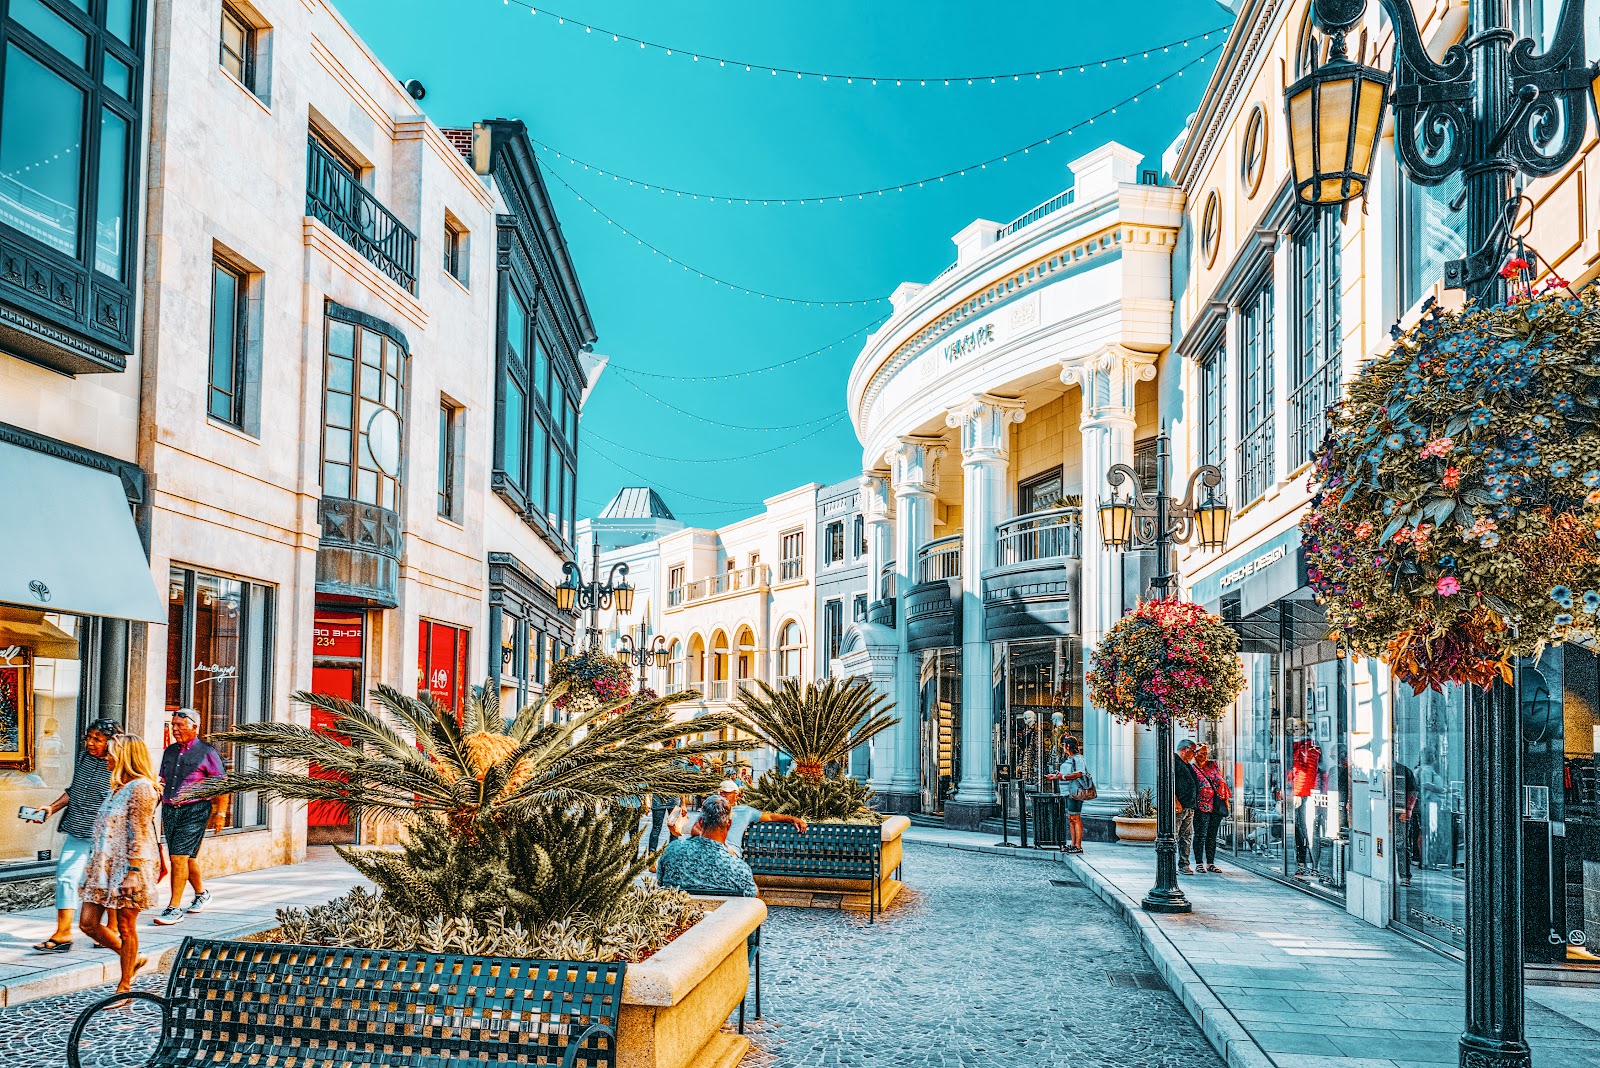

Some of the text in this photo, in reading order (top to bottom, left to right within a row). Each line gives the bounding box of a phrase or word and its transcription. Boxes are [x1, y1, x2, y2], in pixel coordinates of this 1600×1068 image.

[1219, 543, 1287, 589] PORSCHE DESIGN
[316, 636, 336, 647] 234
